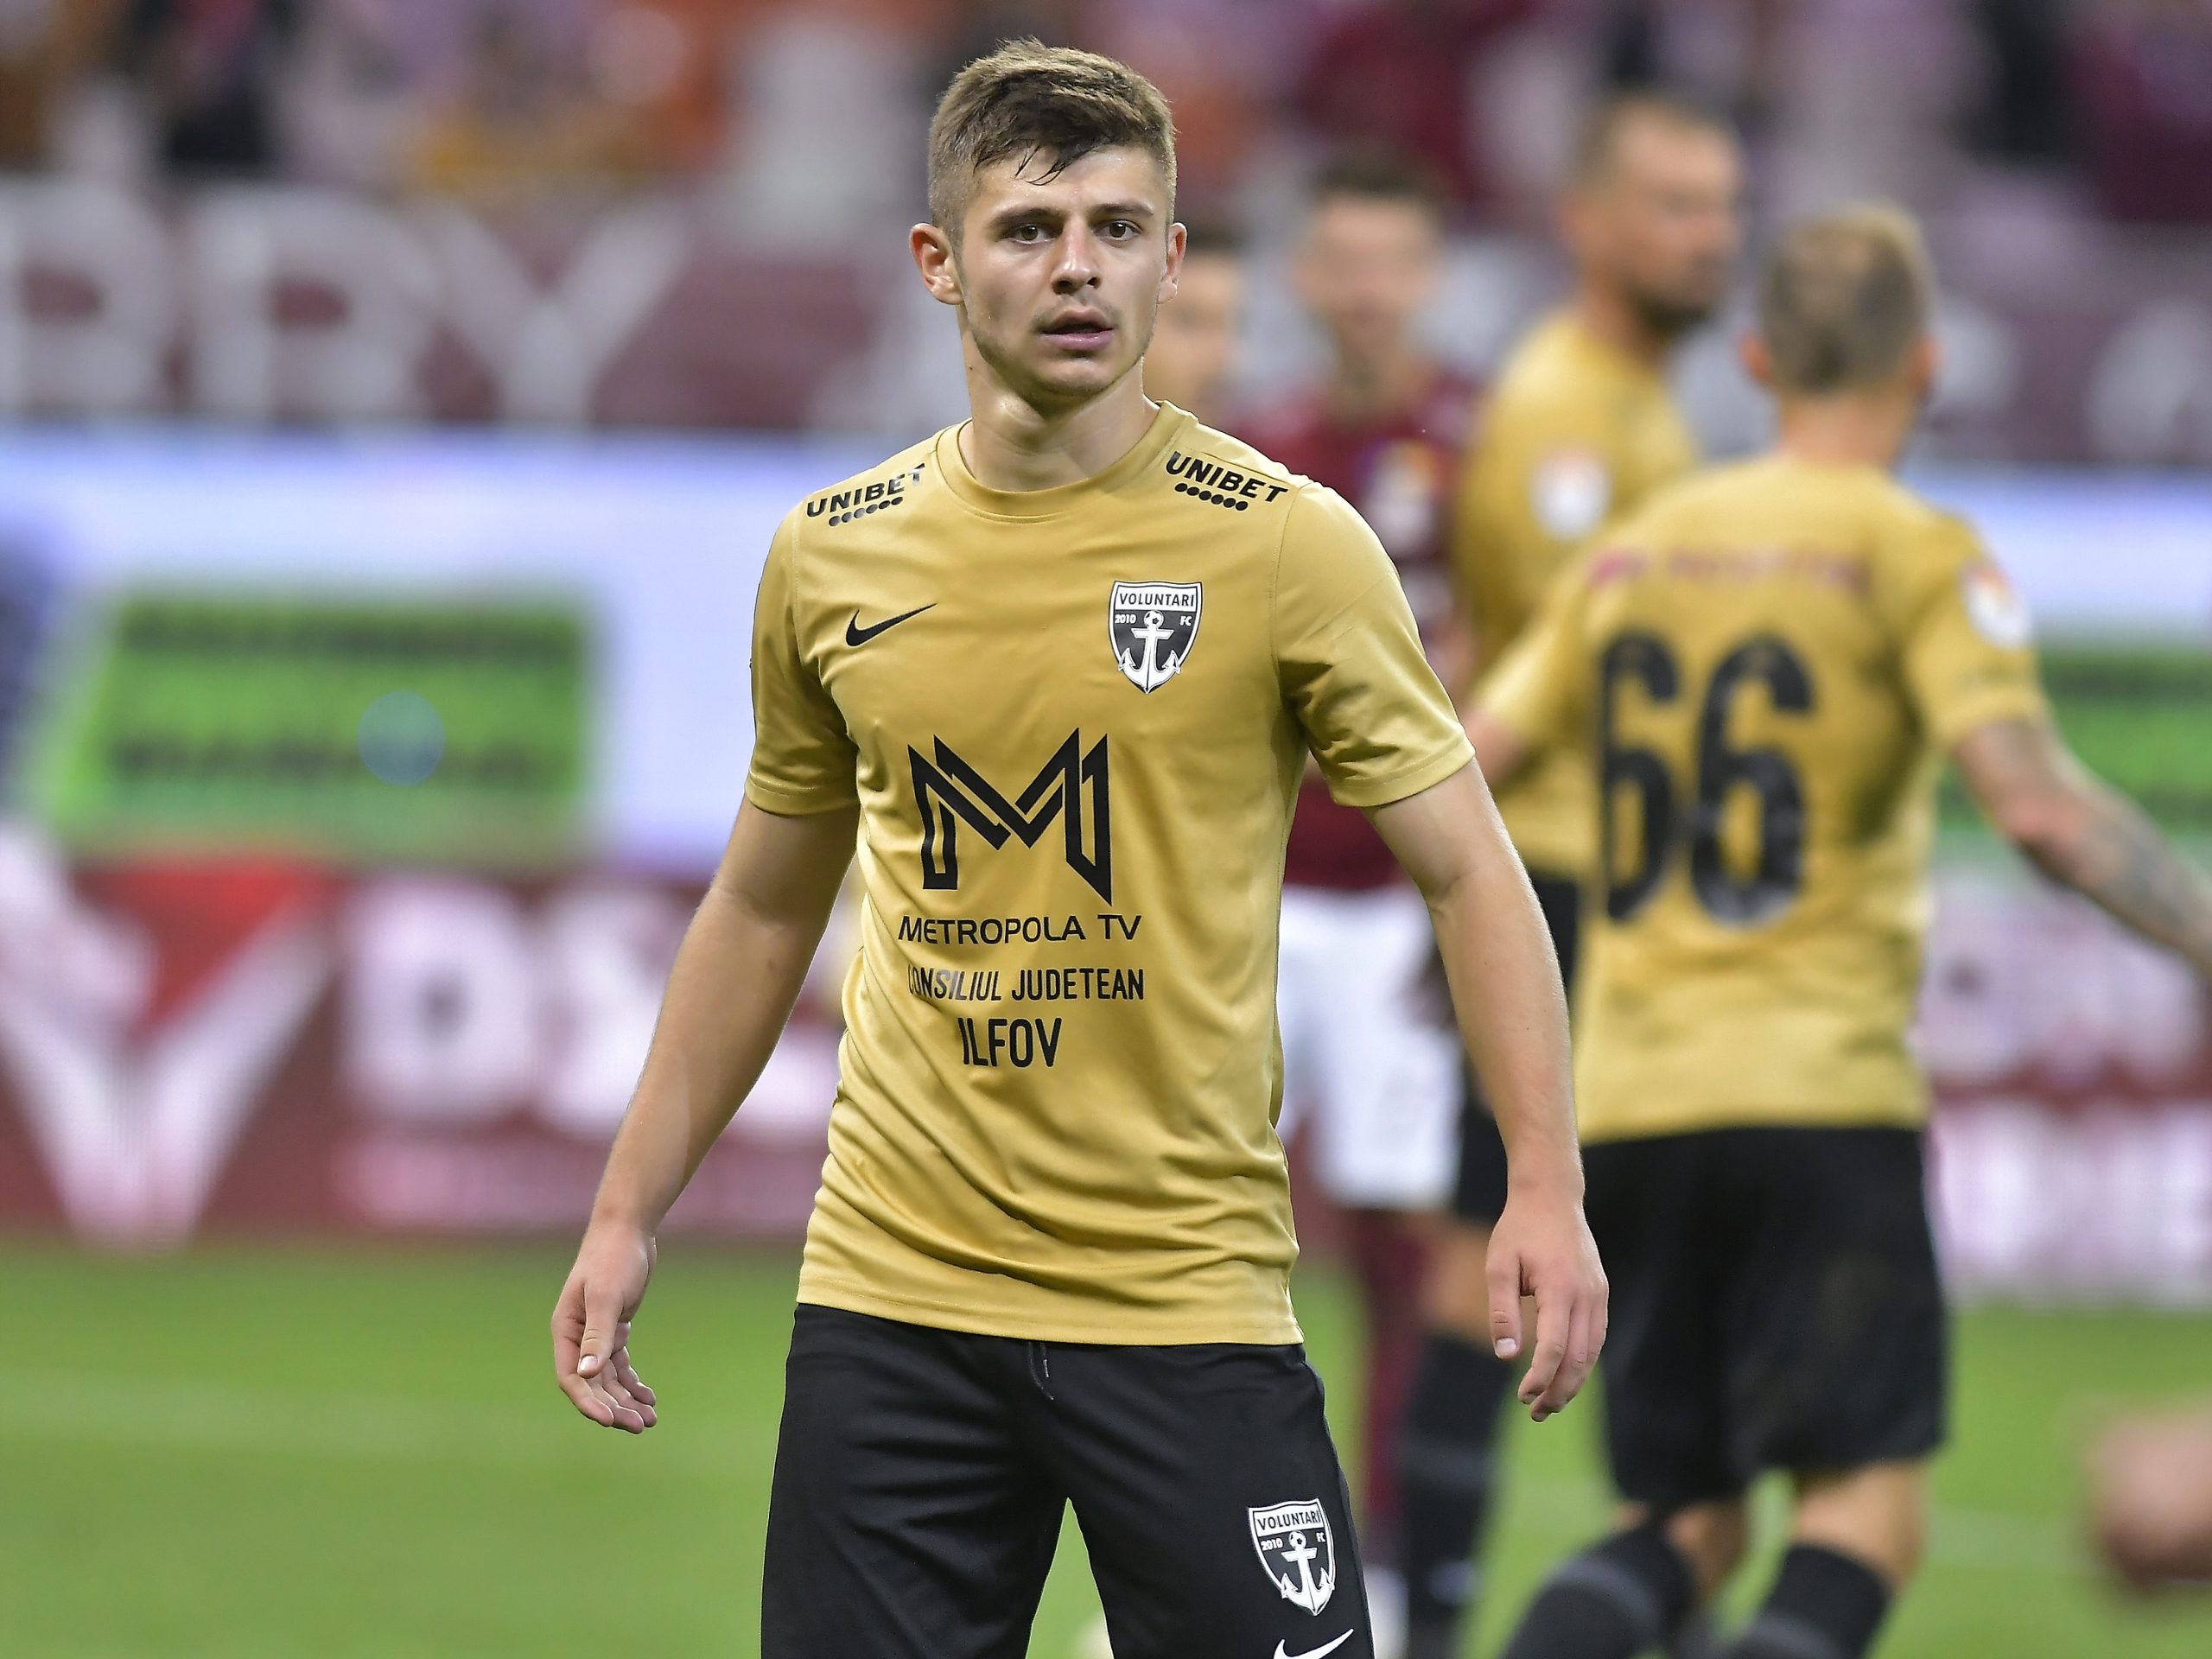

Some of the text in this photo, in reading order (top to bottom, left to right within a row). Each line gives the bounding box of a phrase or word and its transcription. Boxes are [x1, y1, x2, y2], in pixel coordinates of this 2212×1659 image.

[807, 462, 925, 518] UNIBET
[1166, 450, 1289, 503] UNIBET
[1119, 593, 1194, 607] VOLUNTARI
[1114, 613, 1192, 626] 2010 FC
[1599, 629, 1815, 931] 66
[898, 913, 1141, 944] METROPOLA TV
[1011, 968, 1144, 1001] JUDETEAN
[957, 1017, 1062, 1068] ILFOV
[1257, 1510, 1321, 1531] VOLUNTARI
[1261, 1531, 1325, 1552] 2010 FC
